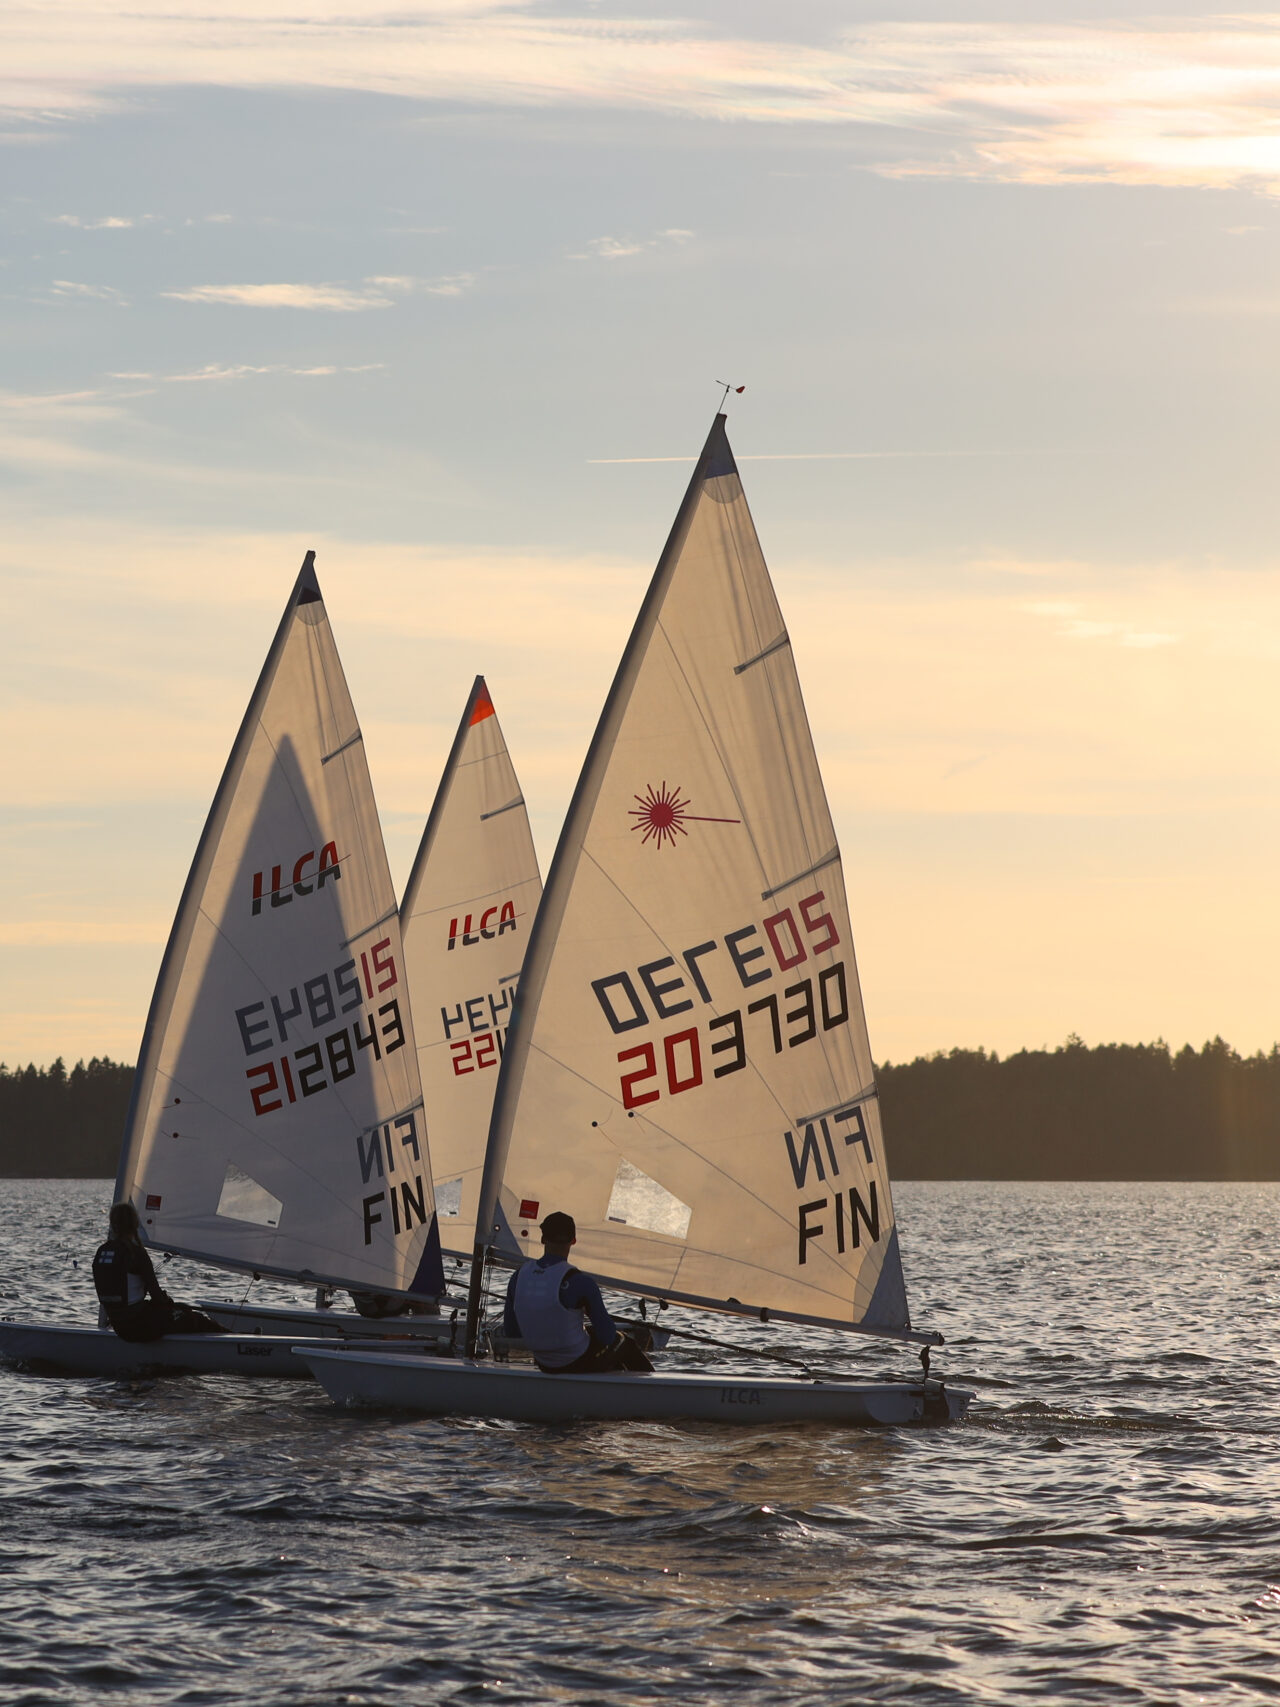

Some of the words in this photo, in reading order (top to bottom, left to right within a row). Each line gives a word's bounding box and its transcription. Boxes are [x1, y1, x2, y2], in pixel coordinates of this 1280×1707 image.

[252, 840, 342, 917] ILCA
[447, 900, 517, 951] ILCA
[245, 998, 406, 1117] 212843
[617, 961, 850, 1110] 203730
[362, 1175, 427, 1246] FIN
[798, 1181, 881, 1266] FIN
[237, 1343, 274, 1356] Laser
[720, 1386, 762, 1405] ILCA
